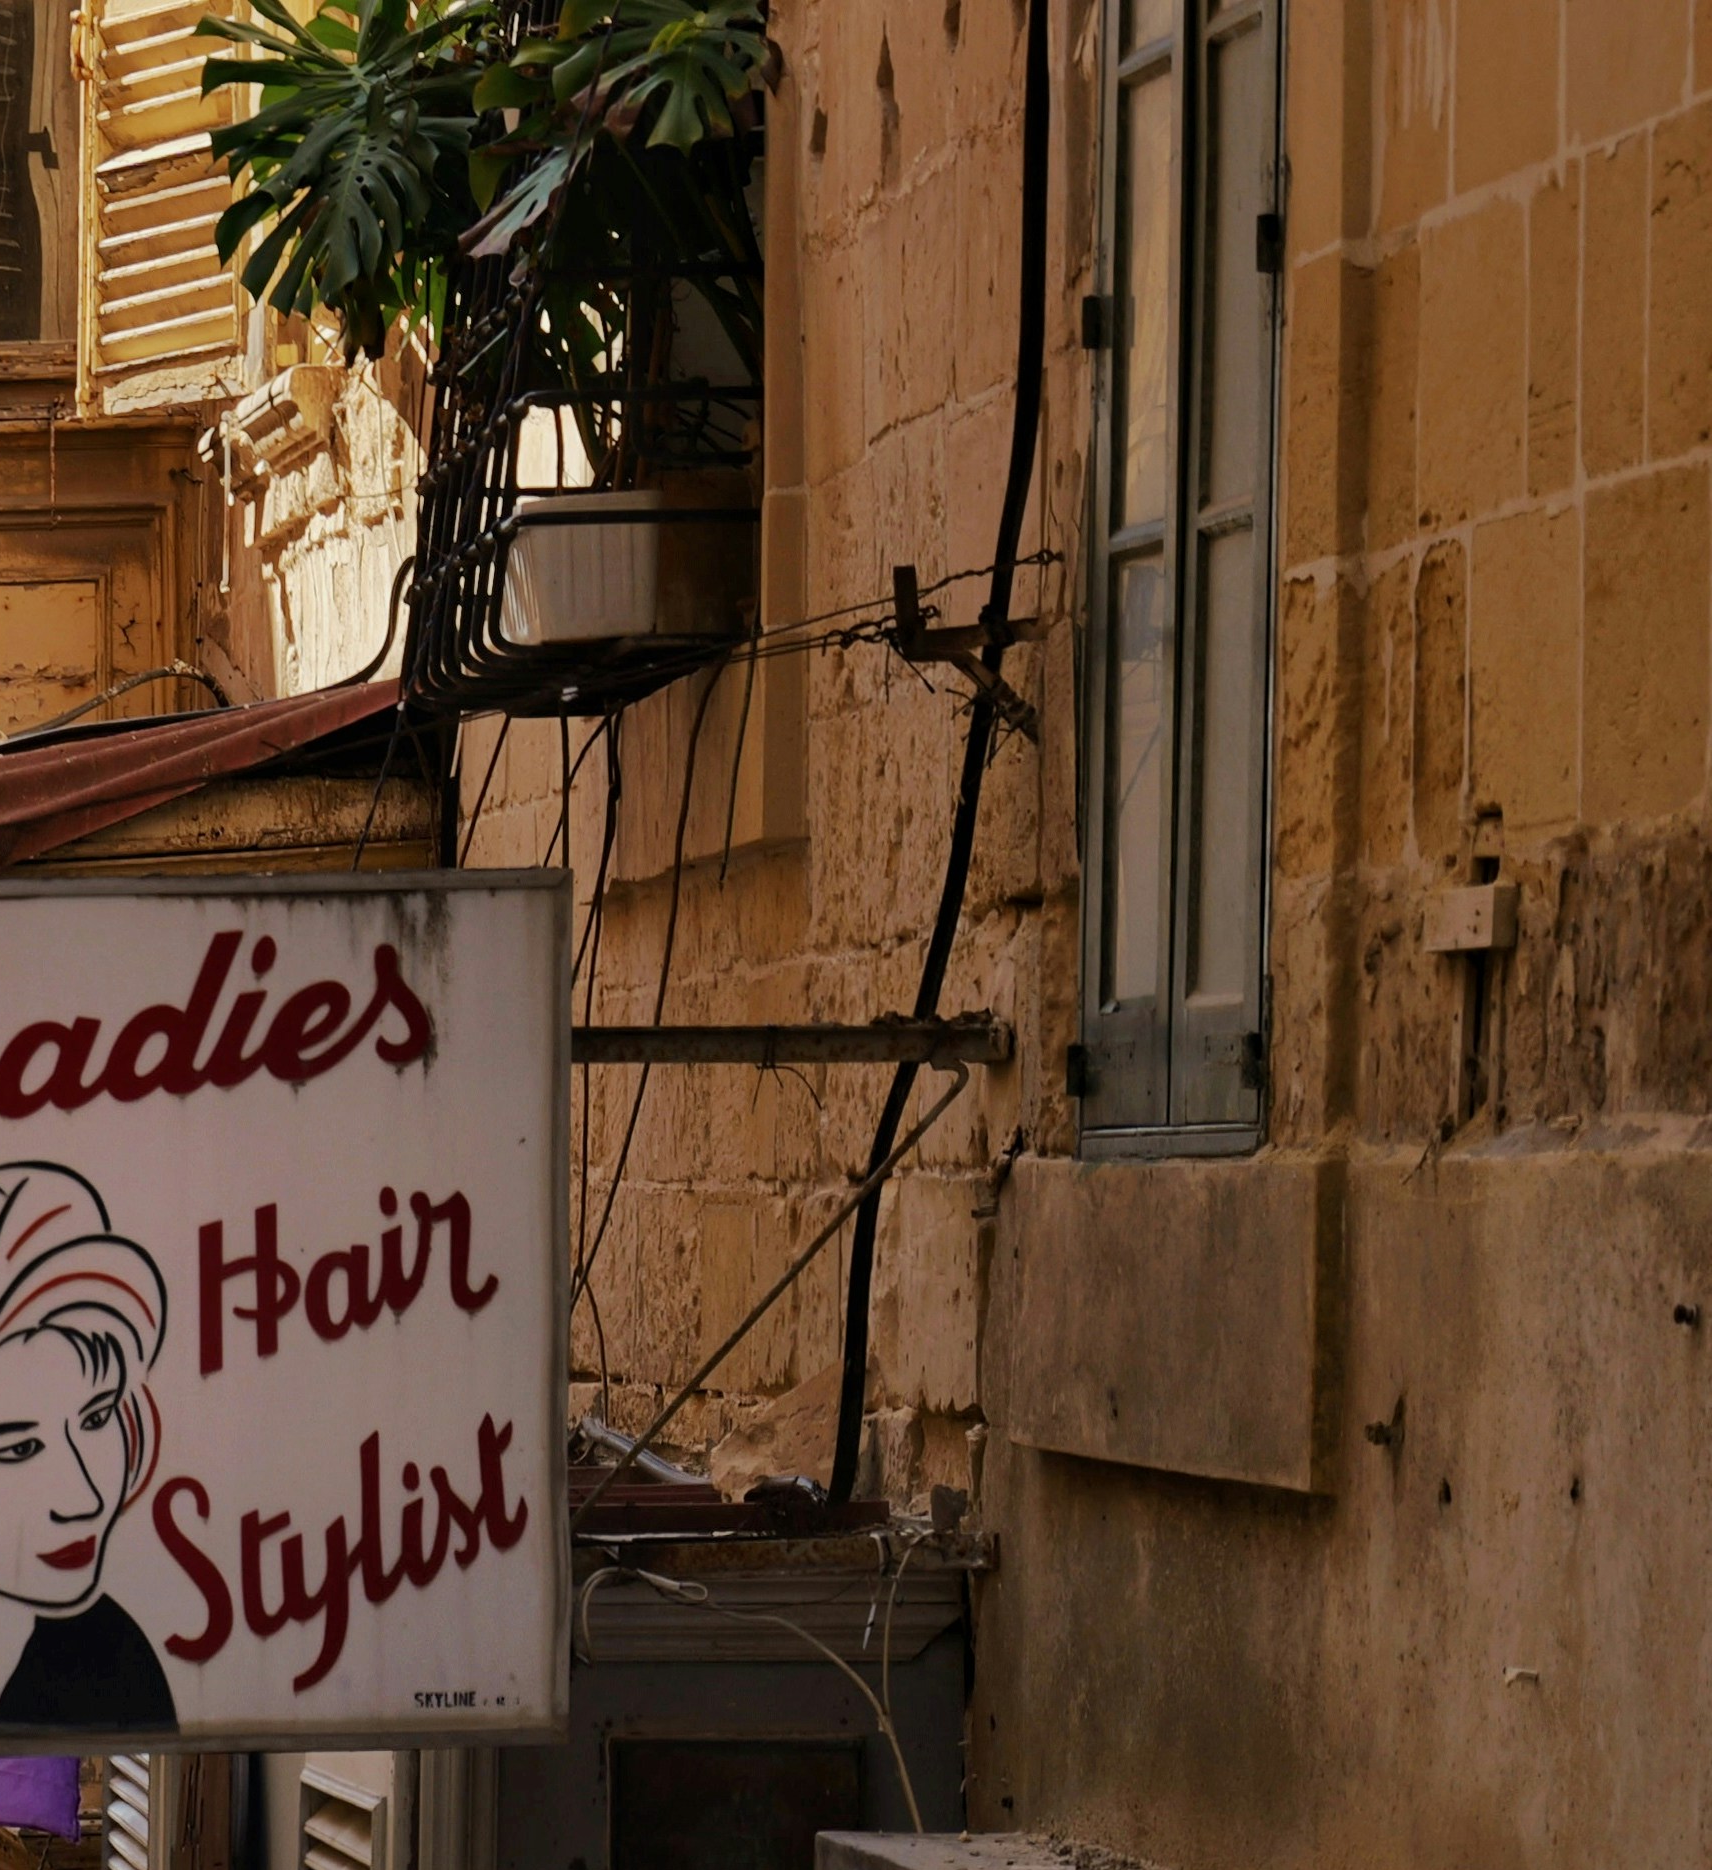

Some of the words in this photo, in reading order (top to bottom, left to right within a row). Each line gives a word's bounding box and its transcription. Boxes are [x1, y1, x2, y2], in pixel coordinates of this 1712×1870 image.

[198, 1186, 499, 1376] Hair
[151, 1412, 529, 1694] Stylist
[414, 1691, 477, 1708] SKYLINE
